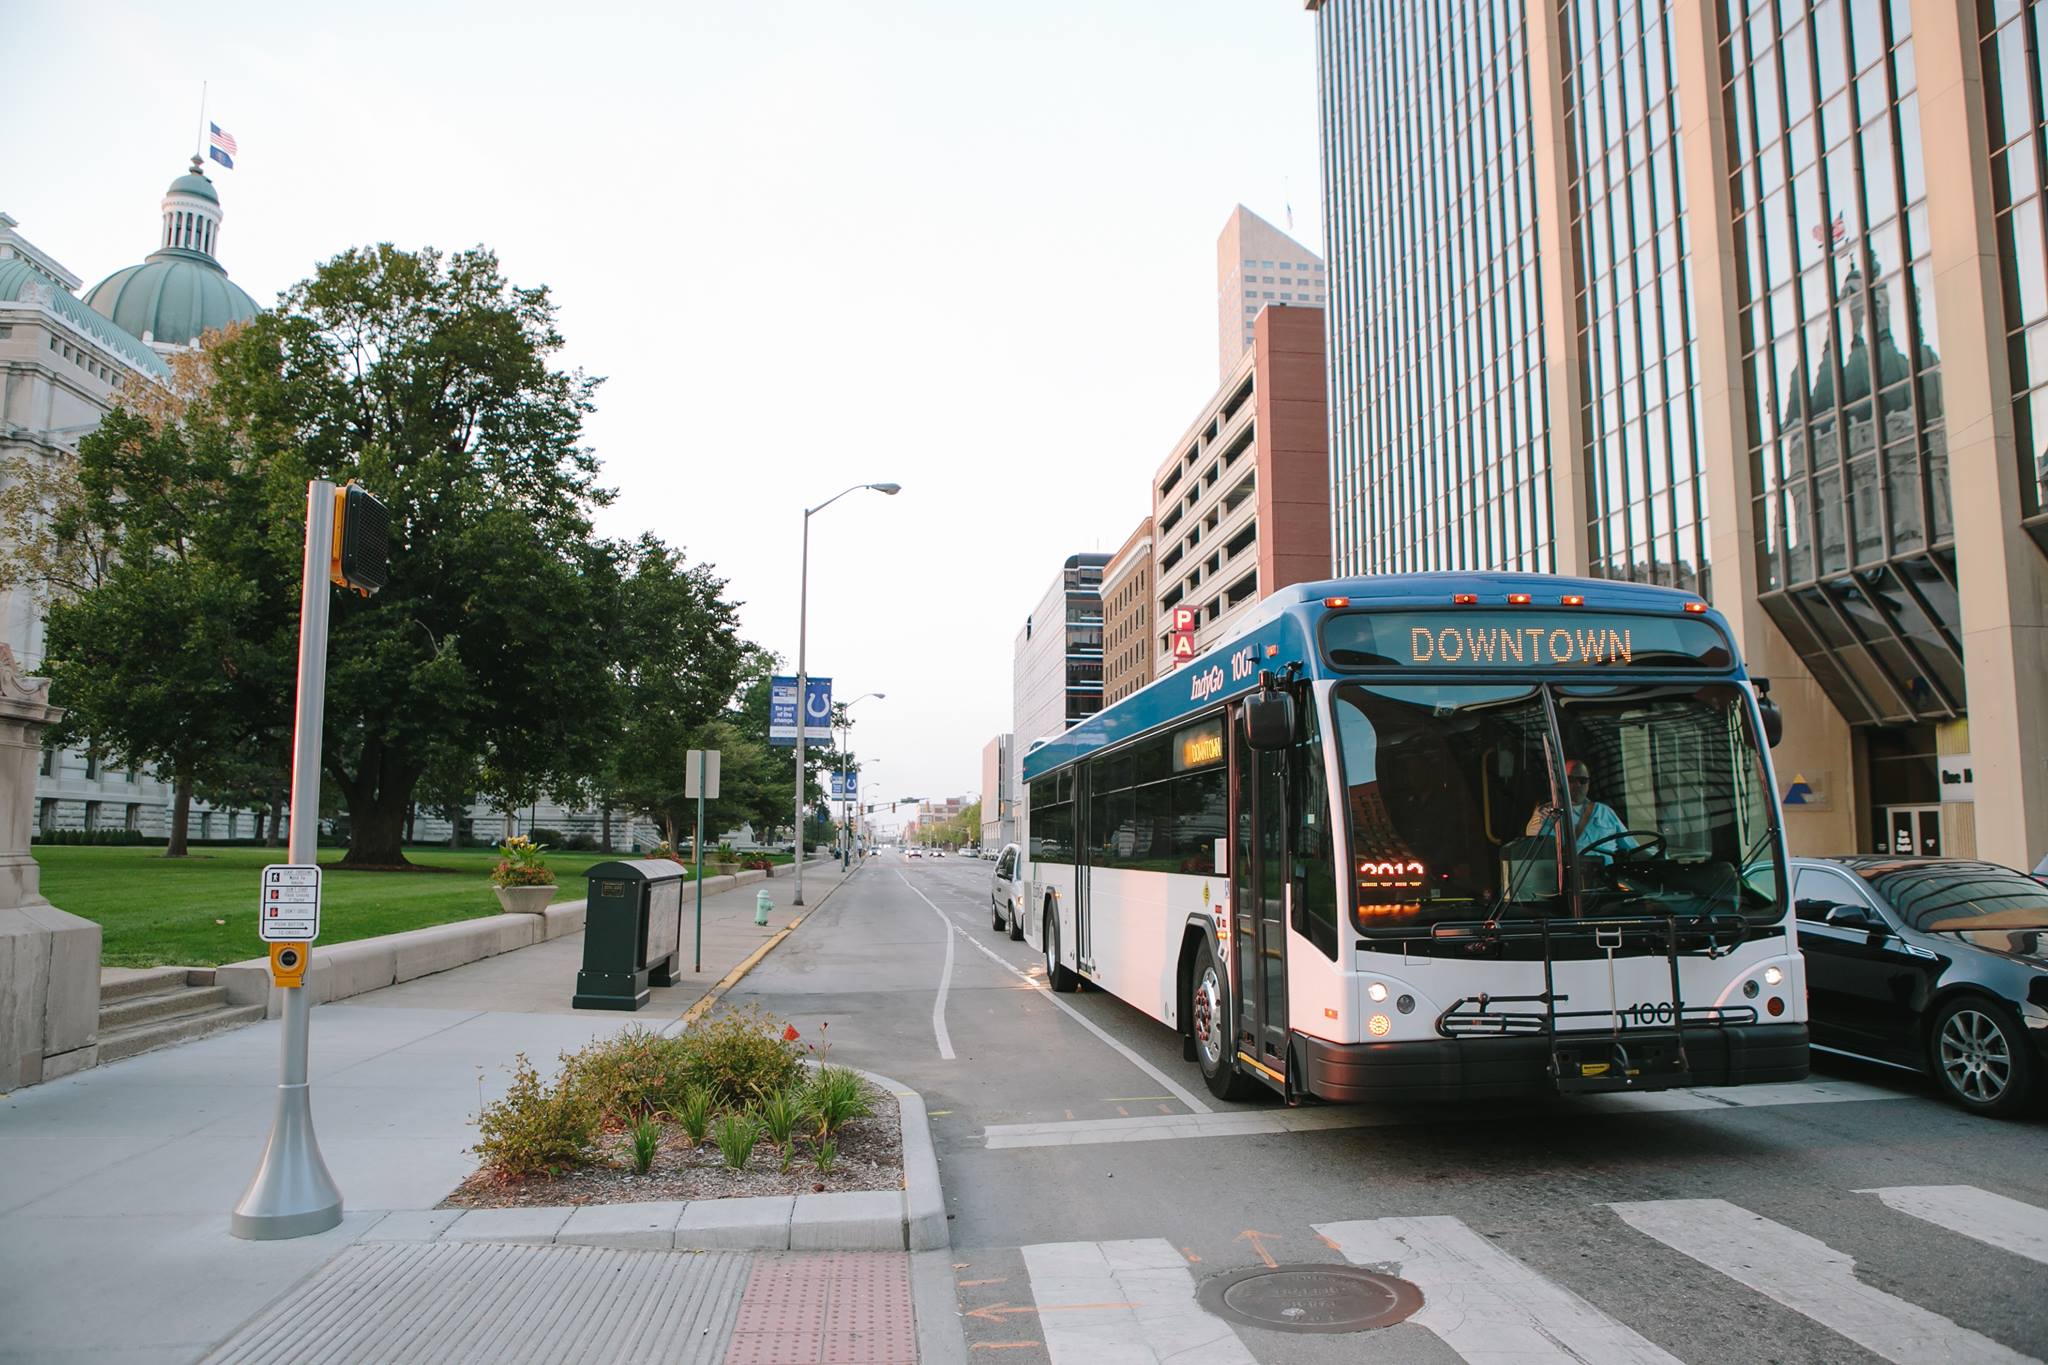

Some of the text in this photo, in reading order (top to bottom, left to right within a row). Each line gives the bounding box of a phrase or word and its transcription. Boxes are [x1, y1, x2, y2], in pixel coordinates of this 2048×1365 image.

[1176, 610, 1192, 669] PA
[1411, 627, 1632, 663] DOWNTOWN
[1191, 665, 1224, 701] IndyGo
